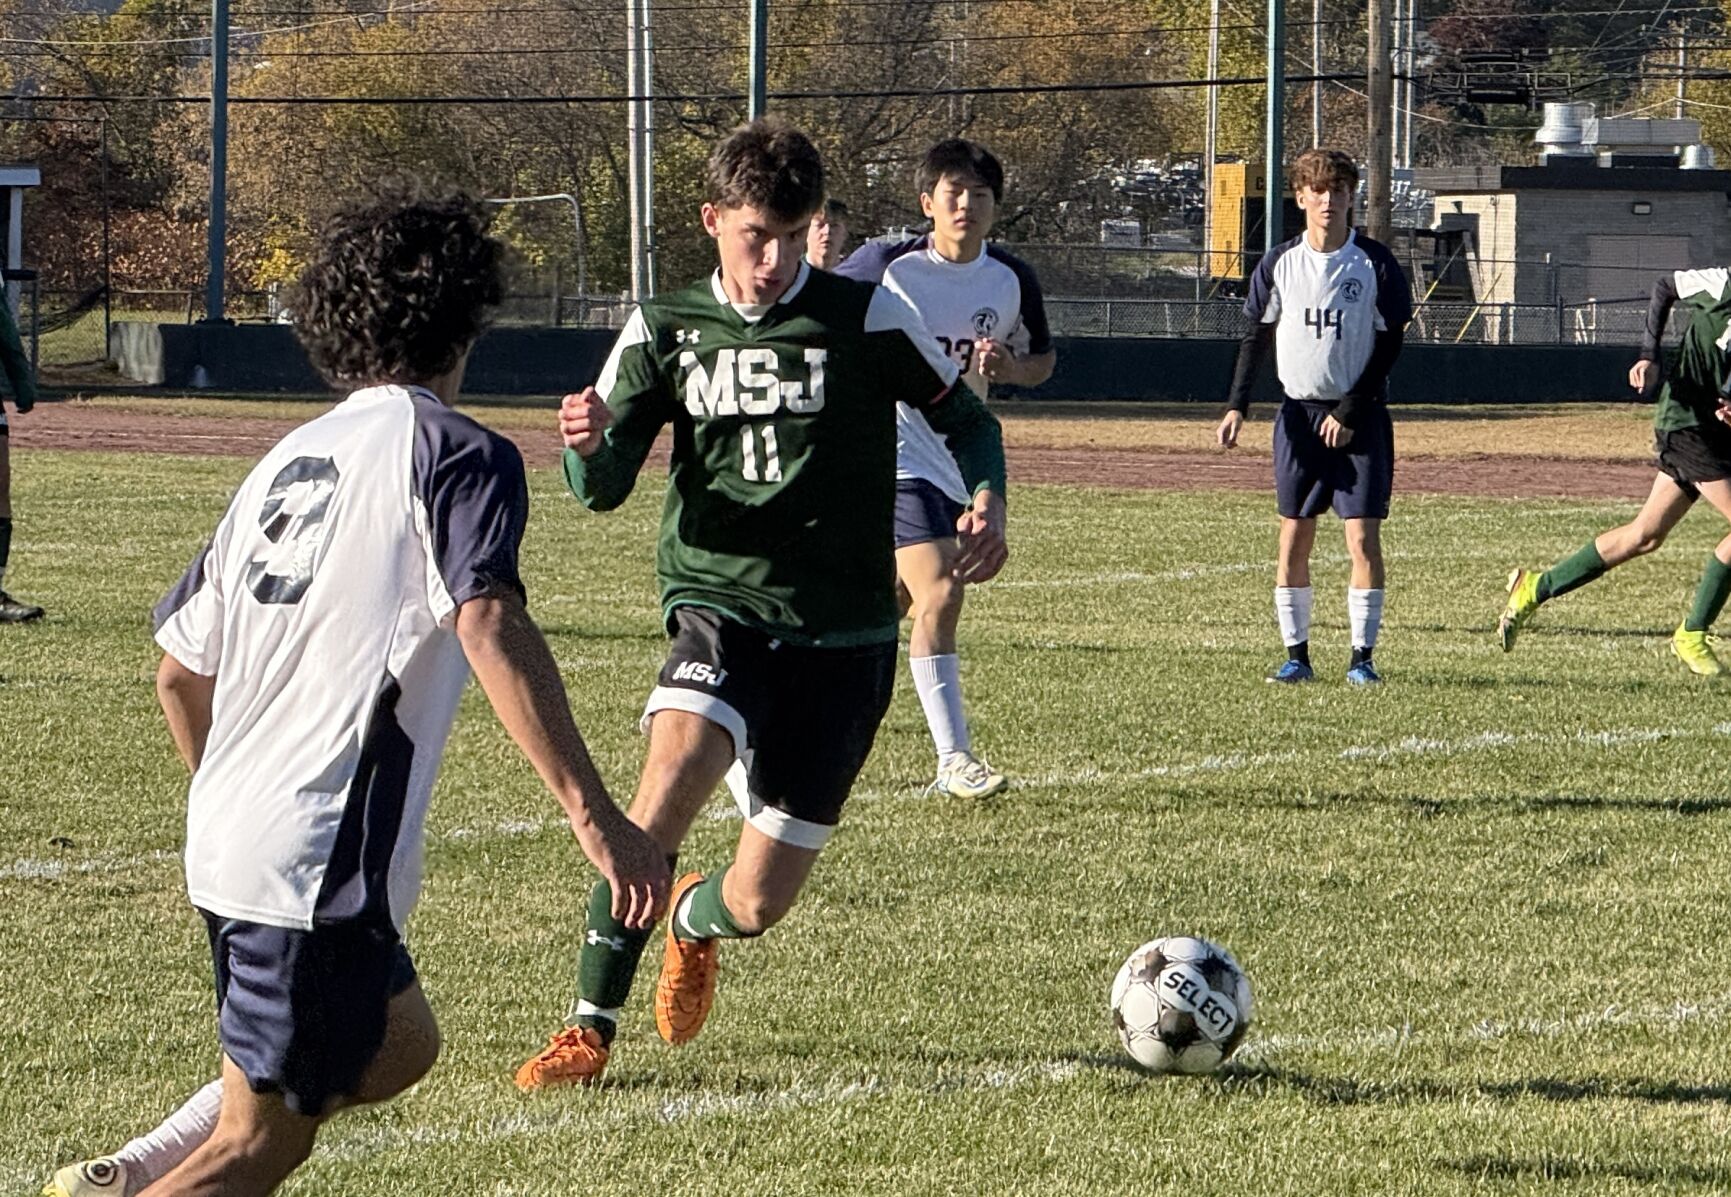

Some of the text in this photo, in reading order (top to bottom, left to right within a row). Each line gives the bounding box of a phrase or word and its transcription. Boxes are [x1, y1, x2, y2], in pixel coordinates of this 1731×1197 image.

[1304, 307, 1343, 341] 44
[679, 348, 828, 418] MSJ
[740, 424, 782, 482] 11
[246, 455, 341, 605] 9
[672, 661, 729, 687] MSJ
[1163, 971, 1234, 1033] SELECT
